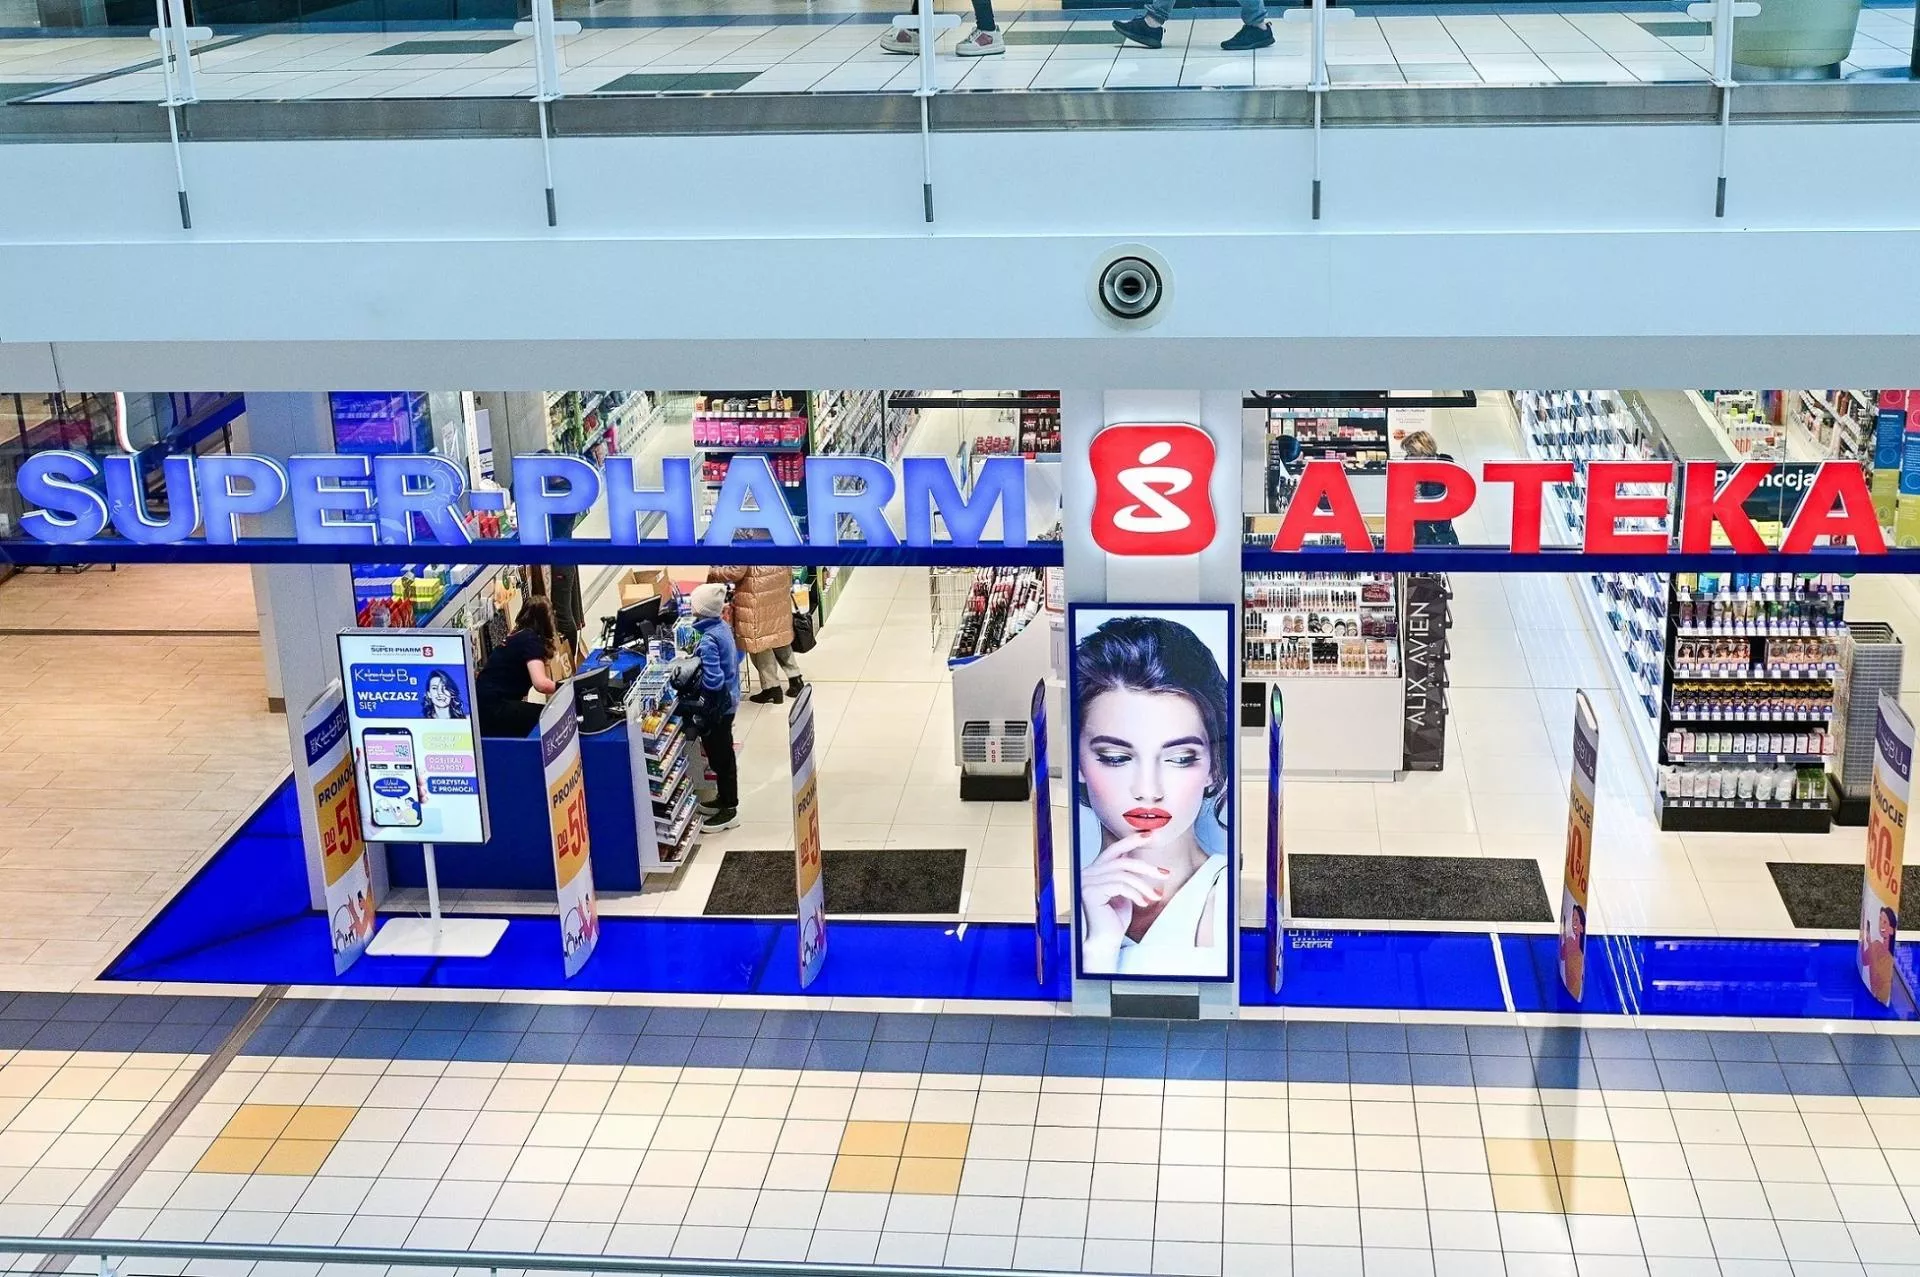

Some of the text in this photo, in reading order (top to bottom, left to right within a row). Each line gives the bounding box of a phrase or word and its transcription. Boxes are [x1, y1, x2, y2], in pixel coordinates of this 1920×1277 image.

[17, 449, 1028, 546] SUPER-PHARM
[1714, 469, 1816, 491] Pmocja
[1272, 458, 1889, 555] APTEKA
[1428, 642, 1437, 688] PARIS
[357, 691, 418, 703] WŁĄCZASZ
